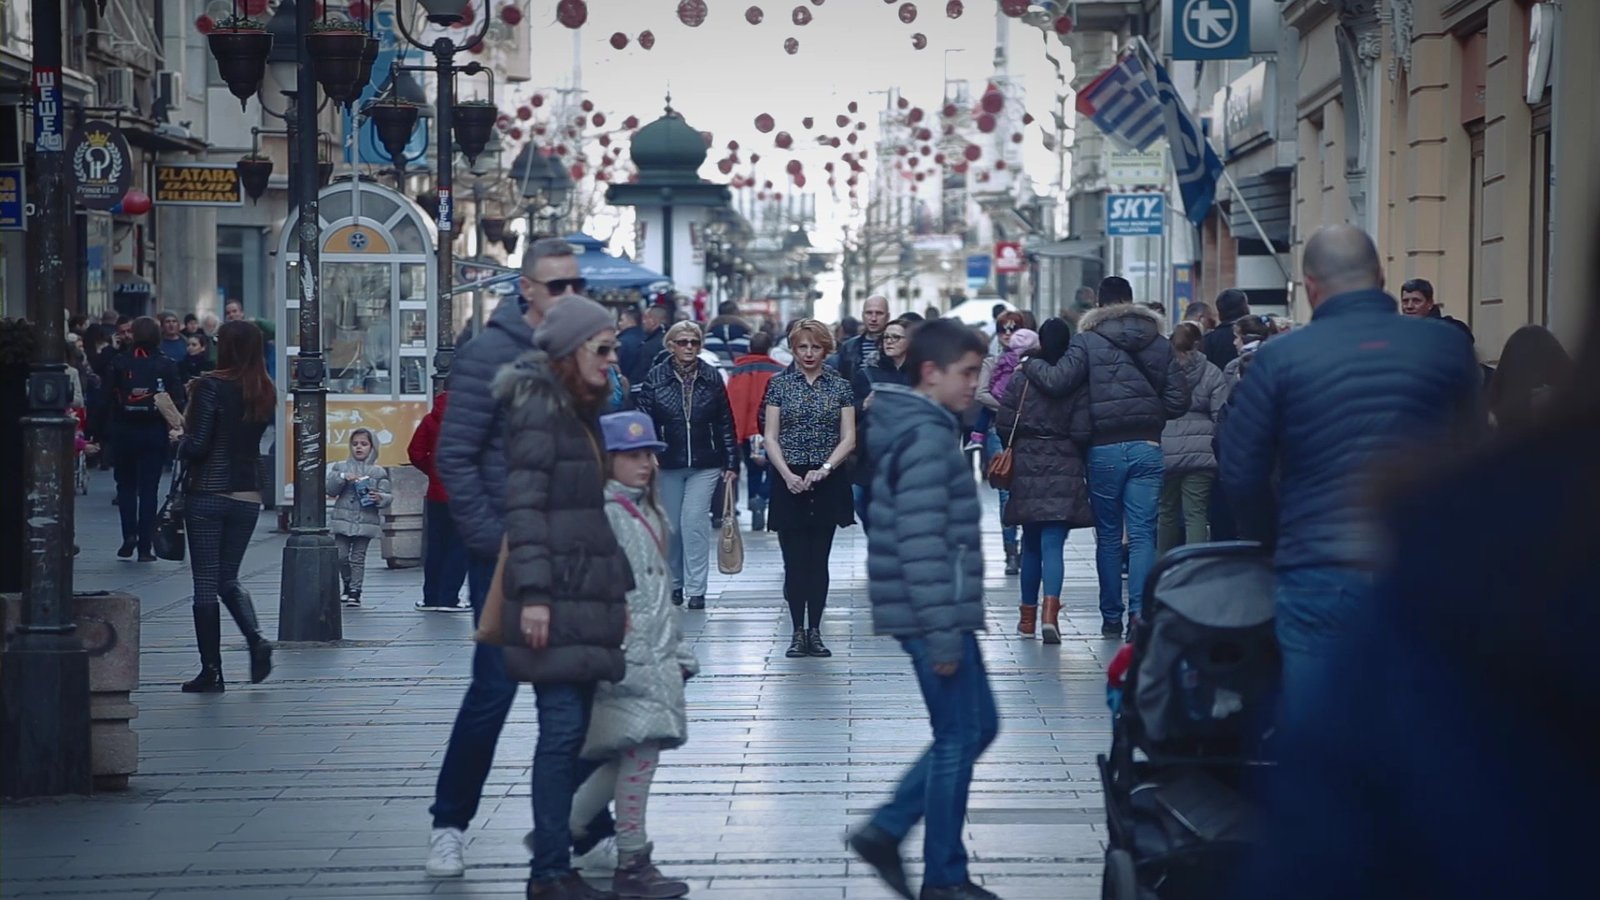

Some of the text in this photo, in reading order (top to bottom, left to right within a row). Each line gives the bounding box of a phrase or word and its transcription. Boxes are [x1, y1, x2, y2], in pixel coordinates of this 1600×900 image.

[159, 168, 237, 181] ZLATARA
[164, 181, 232, 191] DAVID
[158, 190, 237, 201] FILIGRAN
[1110, 197, 1160, 219] SKY
